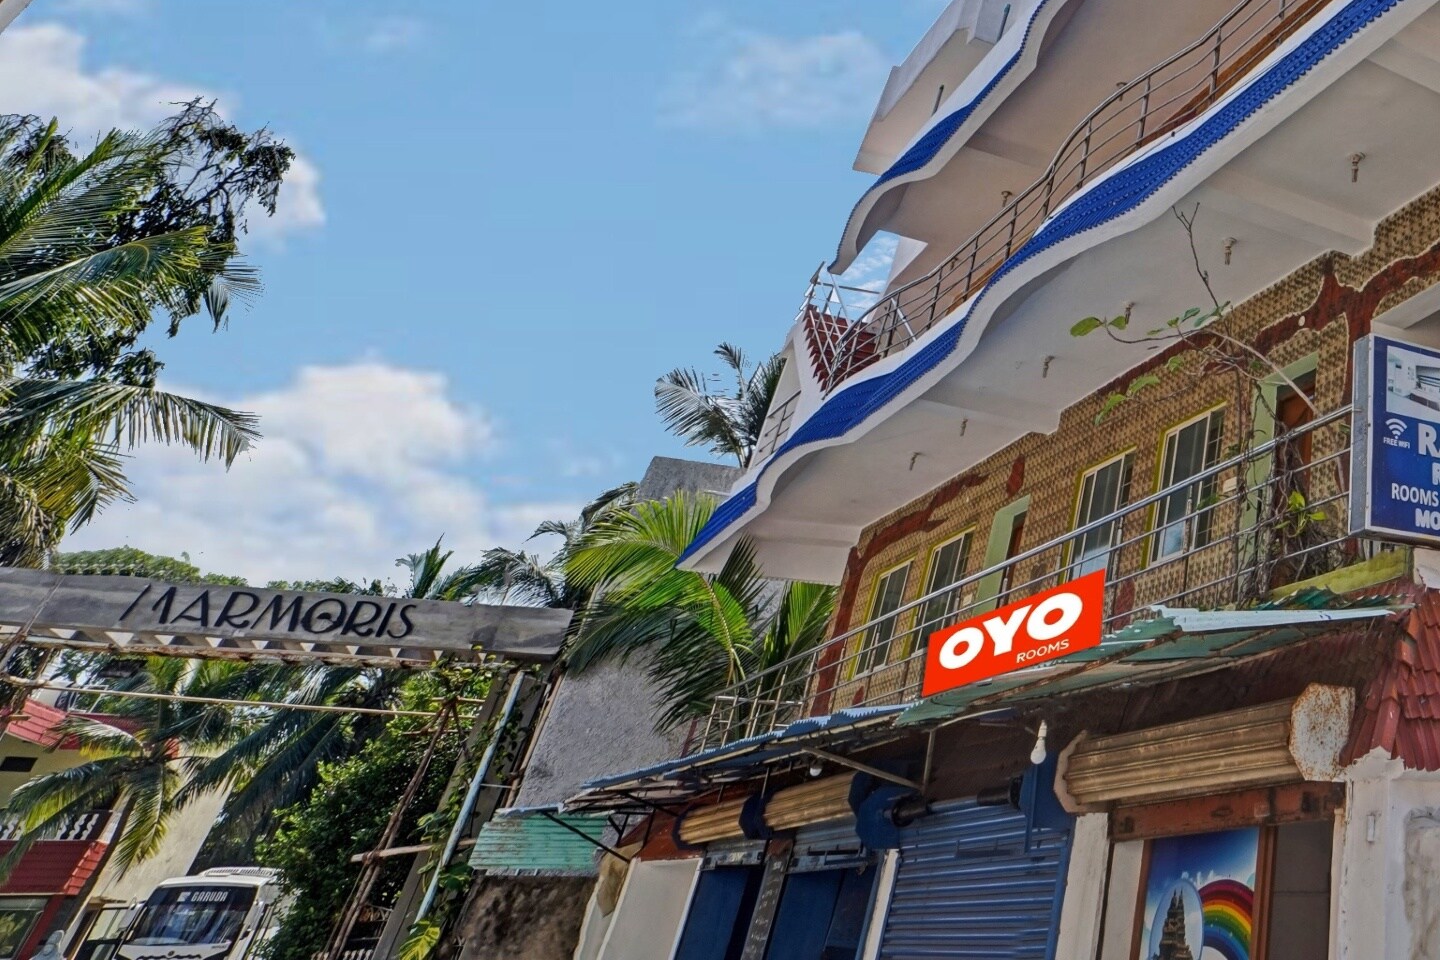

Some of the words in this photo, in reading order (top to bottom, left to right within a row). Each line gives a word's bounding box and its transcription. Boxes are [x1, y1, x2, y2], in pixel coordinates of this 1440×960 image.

[1383, 436, 1398, 447] FREE
[1391, 482, 1440, 508] ROOMS
[118, 583, 419, 639] MARMORIS
[938, 592, 1084, 670] OYO
[1016, 638, 1070, 664] ROOMS
[190, 891, 229, 902] GARUDA
